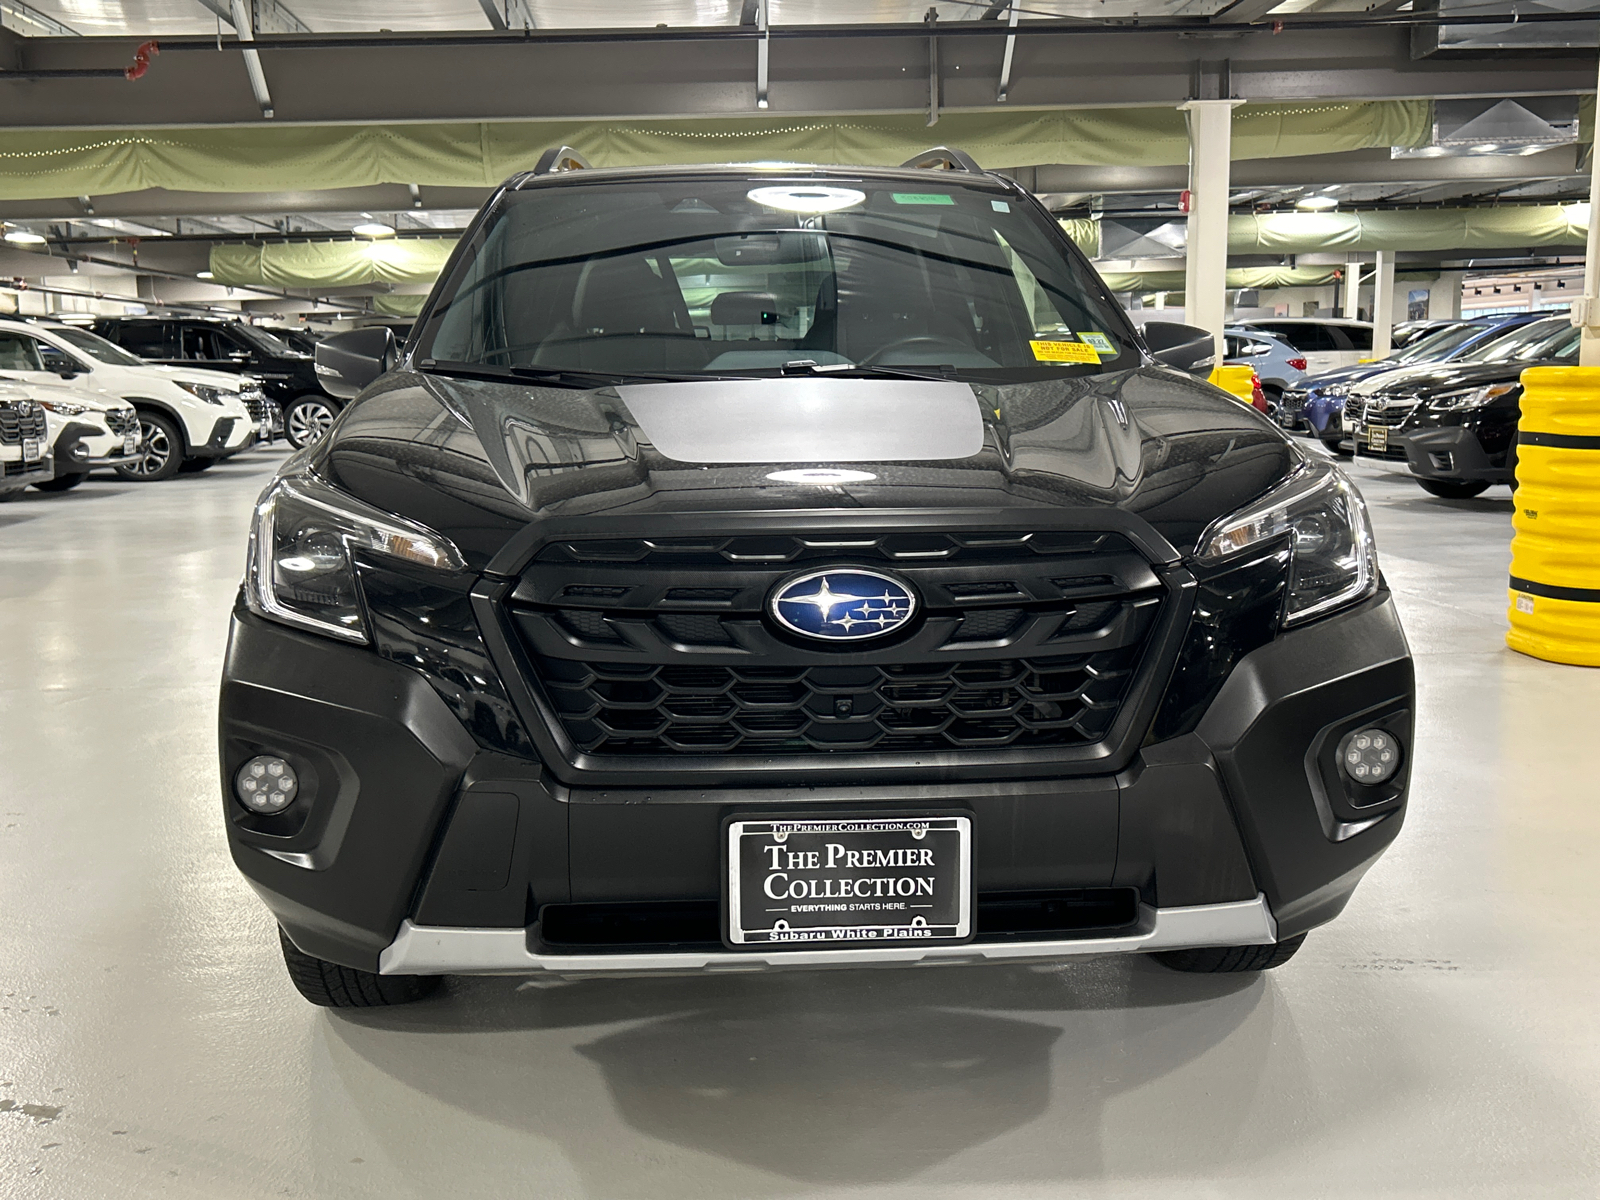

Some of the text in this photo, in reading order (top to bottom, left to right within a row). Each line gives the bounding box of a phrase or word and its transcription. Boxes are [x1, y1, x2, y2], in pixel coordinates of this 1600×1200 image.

[763, 843, 936, 870] THE PREMIER
[763, 873, 936, 900] COLLECTION
[790, 903, 847, 913] EVERYTHING
[849, 903, 881, 911] STARTS
[769, 928, 932, 940] Subaru White Plains
